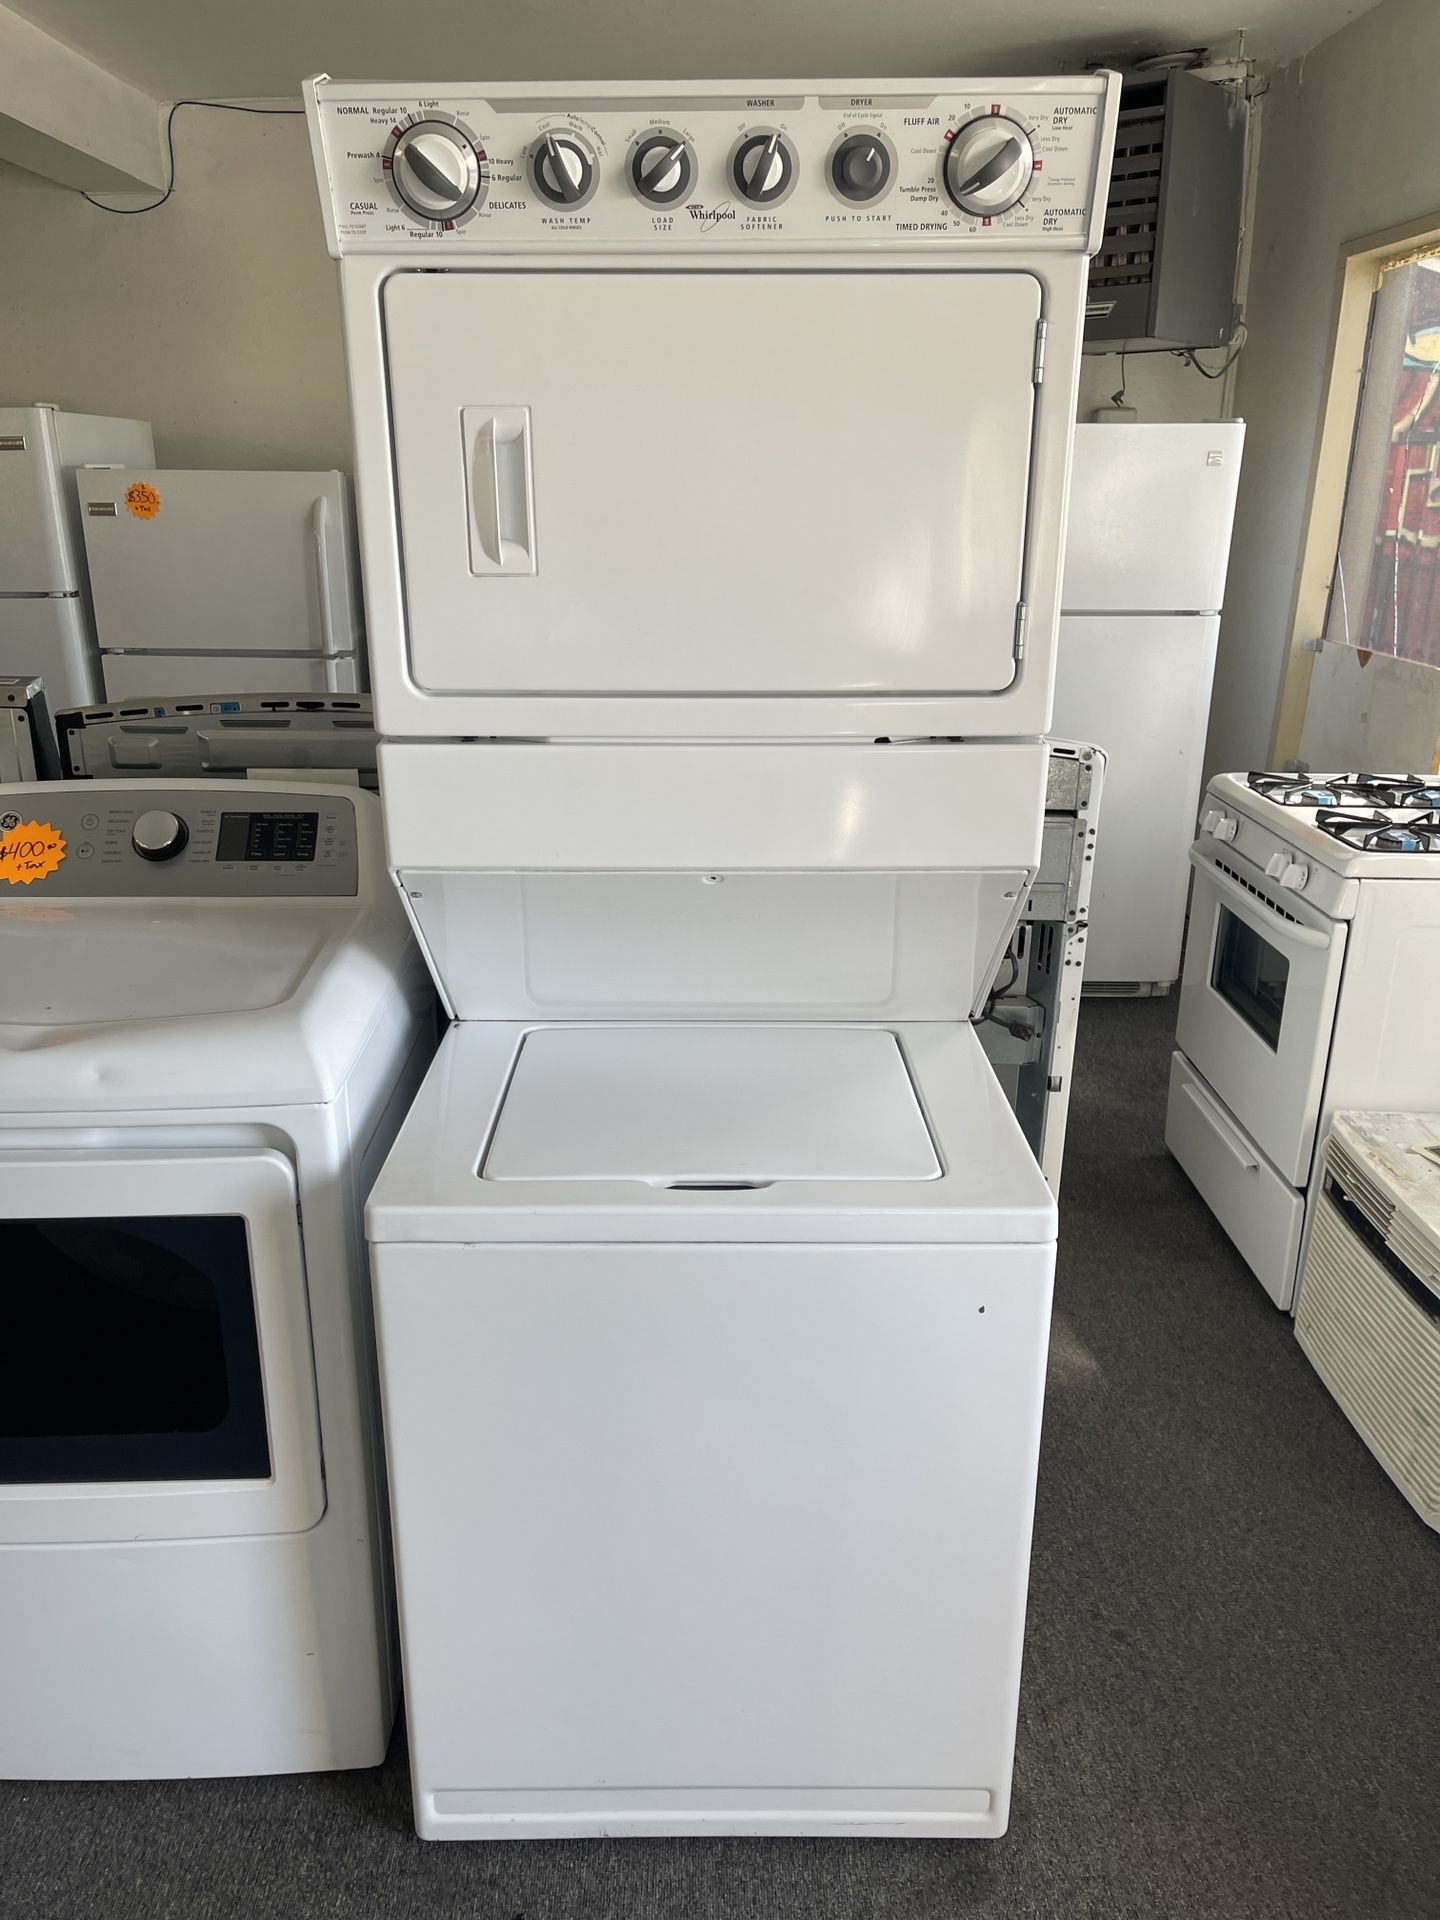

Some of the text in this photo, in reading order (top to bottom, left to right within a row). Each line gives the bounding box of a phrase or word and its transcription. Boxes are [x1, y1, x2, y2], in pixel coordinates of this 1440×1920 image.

[747, 99, 775, 107] WASHER
[336, 107, 369, 115] NORMAL
[372, 107, 398, 116] Regular
[1053, 107, 1097, 115] AUTOMATIC
[370, 117, 388, 125] Heavy
[903, 118, 925, 126] FLUFF
[737, 122, 746, 132] Off
[780, 123, 788, 131] On
[837, 121, 846, 131] Off
[879, 122, 888, 130] On
[497, 174, 523, 183] Regular
[350, 202, 378, 210] CASUAL
[489, 202, 527, 210] DELICATES
[689, 210, 736, 222] Whirlpool
[1043, 208, 1087, 216] AUTOMATIC
[1043, 218, 1058, 226] DRY
[385, 224, 400, 232] Light
[740, 223, 783, 231] SOFTENER
[895, 223, 948, 231] TIMED DRYING
[409, 231, 434, 239] Regular
